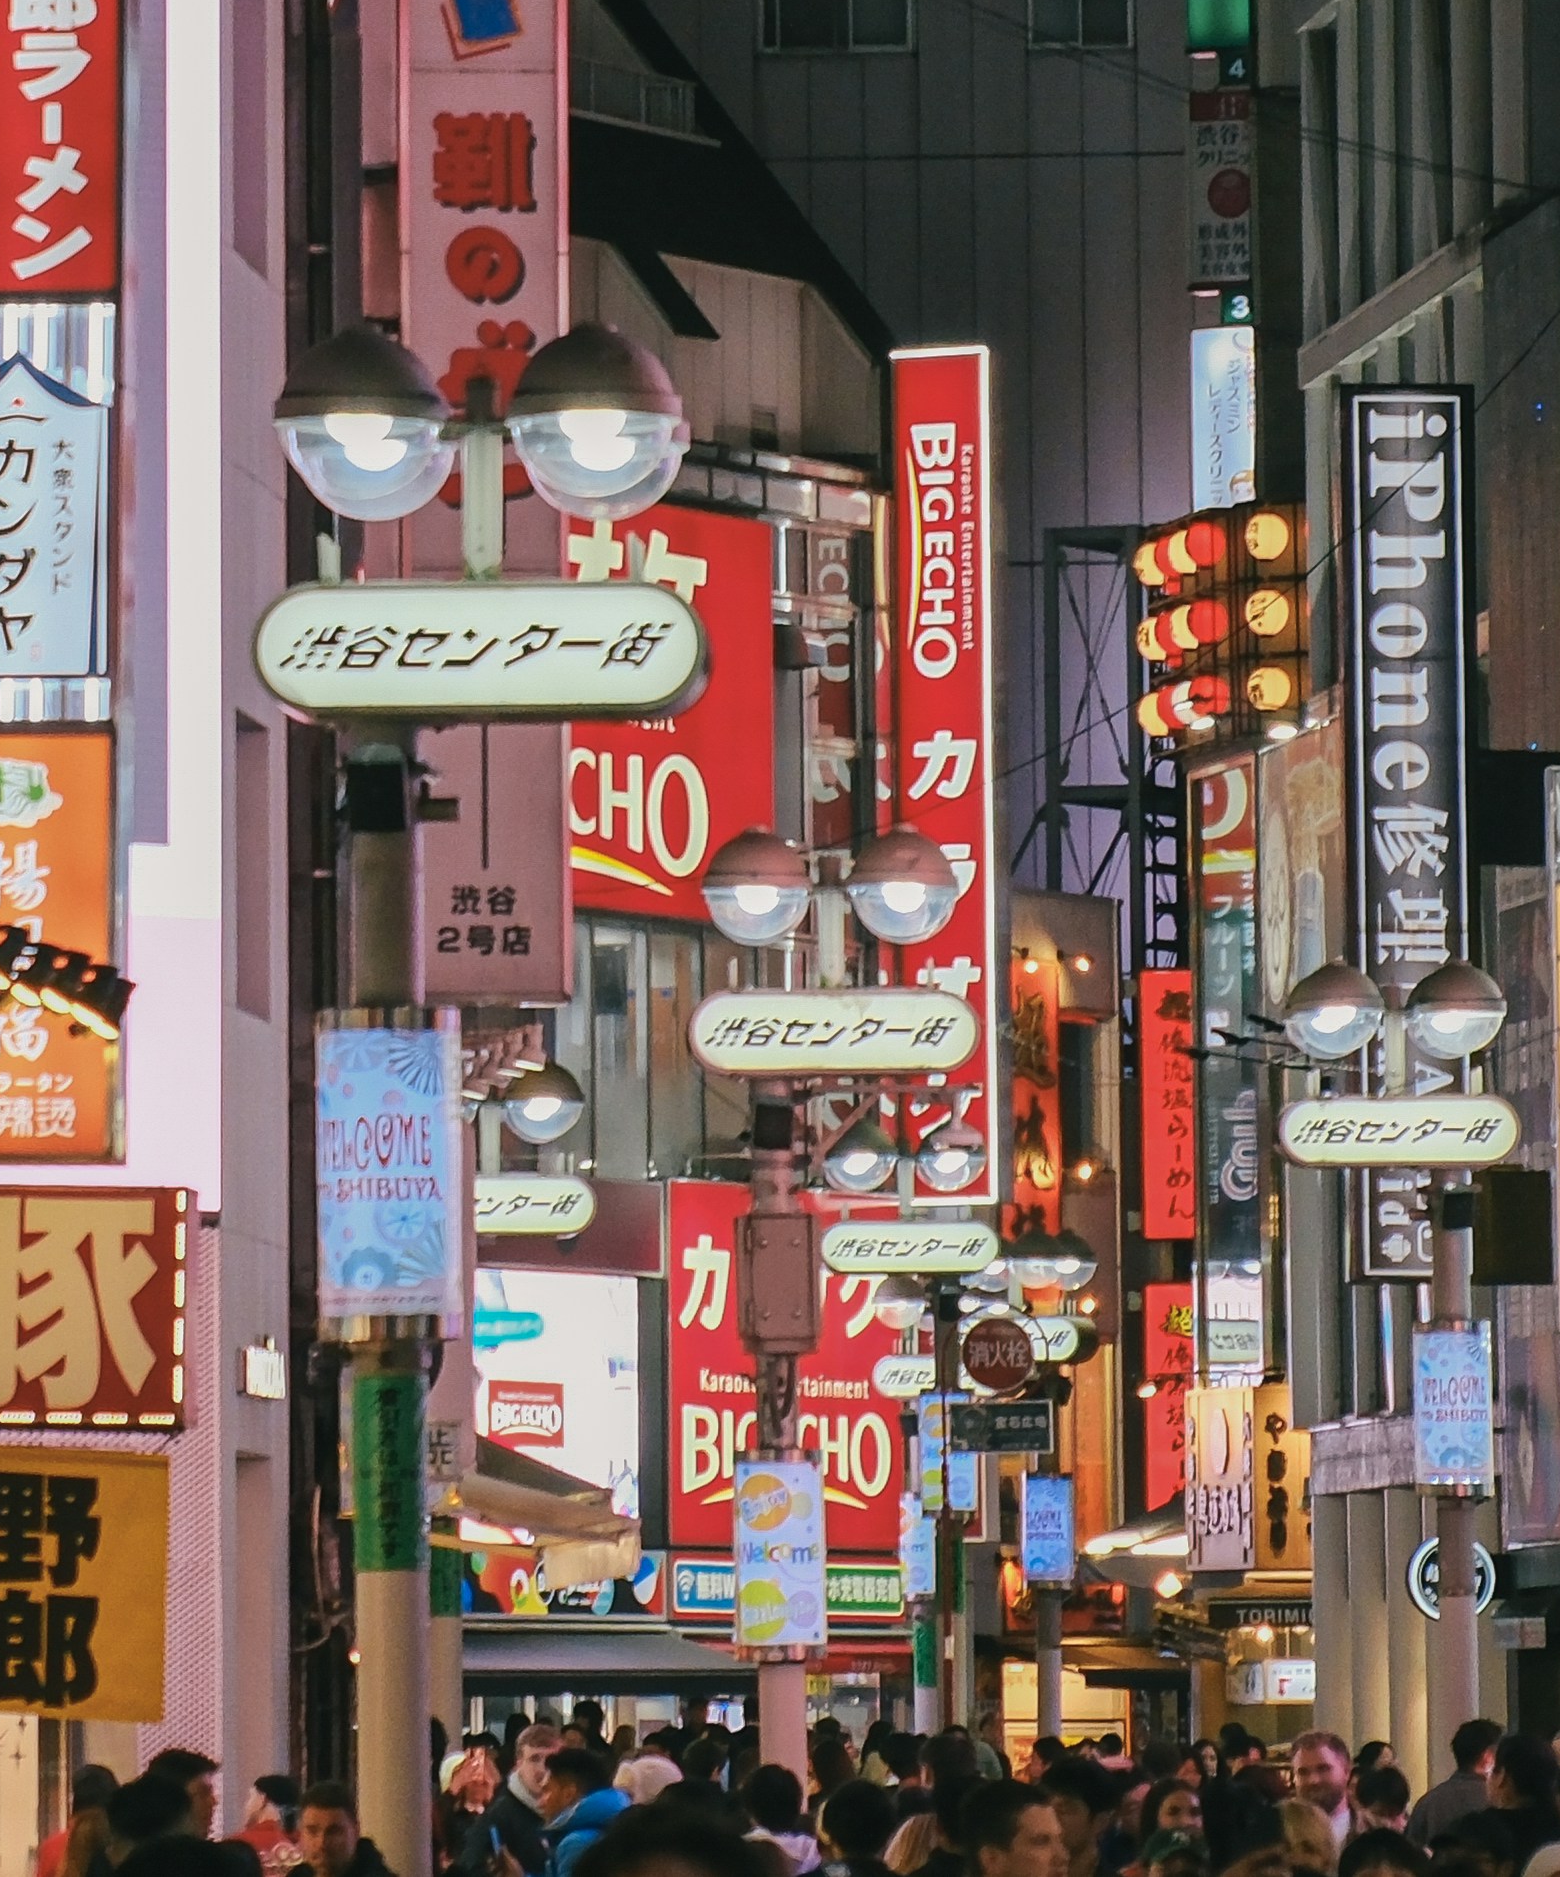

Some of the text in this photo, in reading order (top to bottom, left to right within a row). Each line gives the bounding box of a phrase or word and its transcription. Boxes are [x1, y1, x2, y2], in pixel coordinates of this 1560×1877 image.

[1230, 295, 1251, 320] 3
[909, 421, 959, 681] BIG ECHO
[279, 621, 676, 673] 渋谷センター街
[450, 885, 517, 915] 渋谷
[436, 926, 533, 957] 2号店
[704, 1016, 958, 1048] 渋谷センター街
[1293, 1117, 1504, 1148] 渋谷センター街
[829, 1233, 988, 1259] 渋谷センター街
[968, 1340, 1030, 1369] 消火栓
[700, 1368, 757, 1394] Karaok
[798, 1412, 893, 1498] CHO
